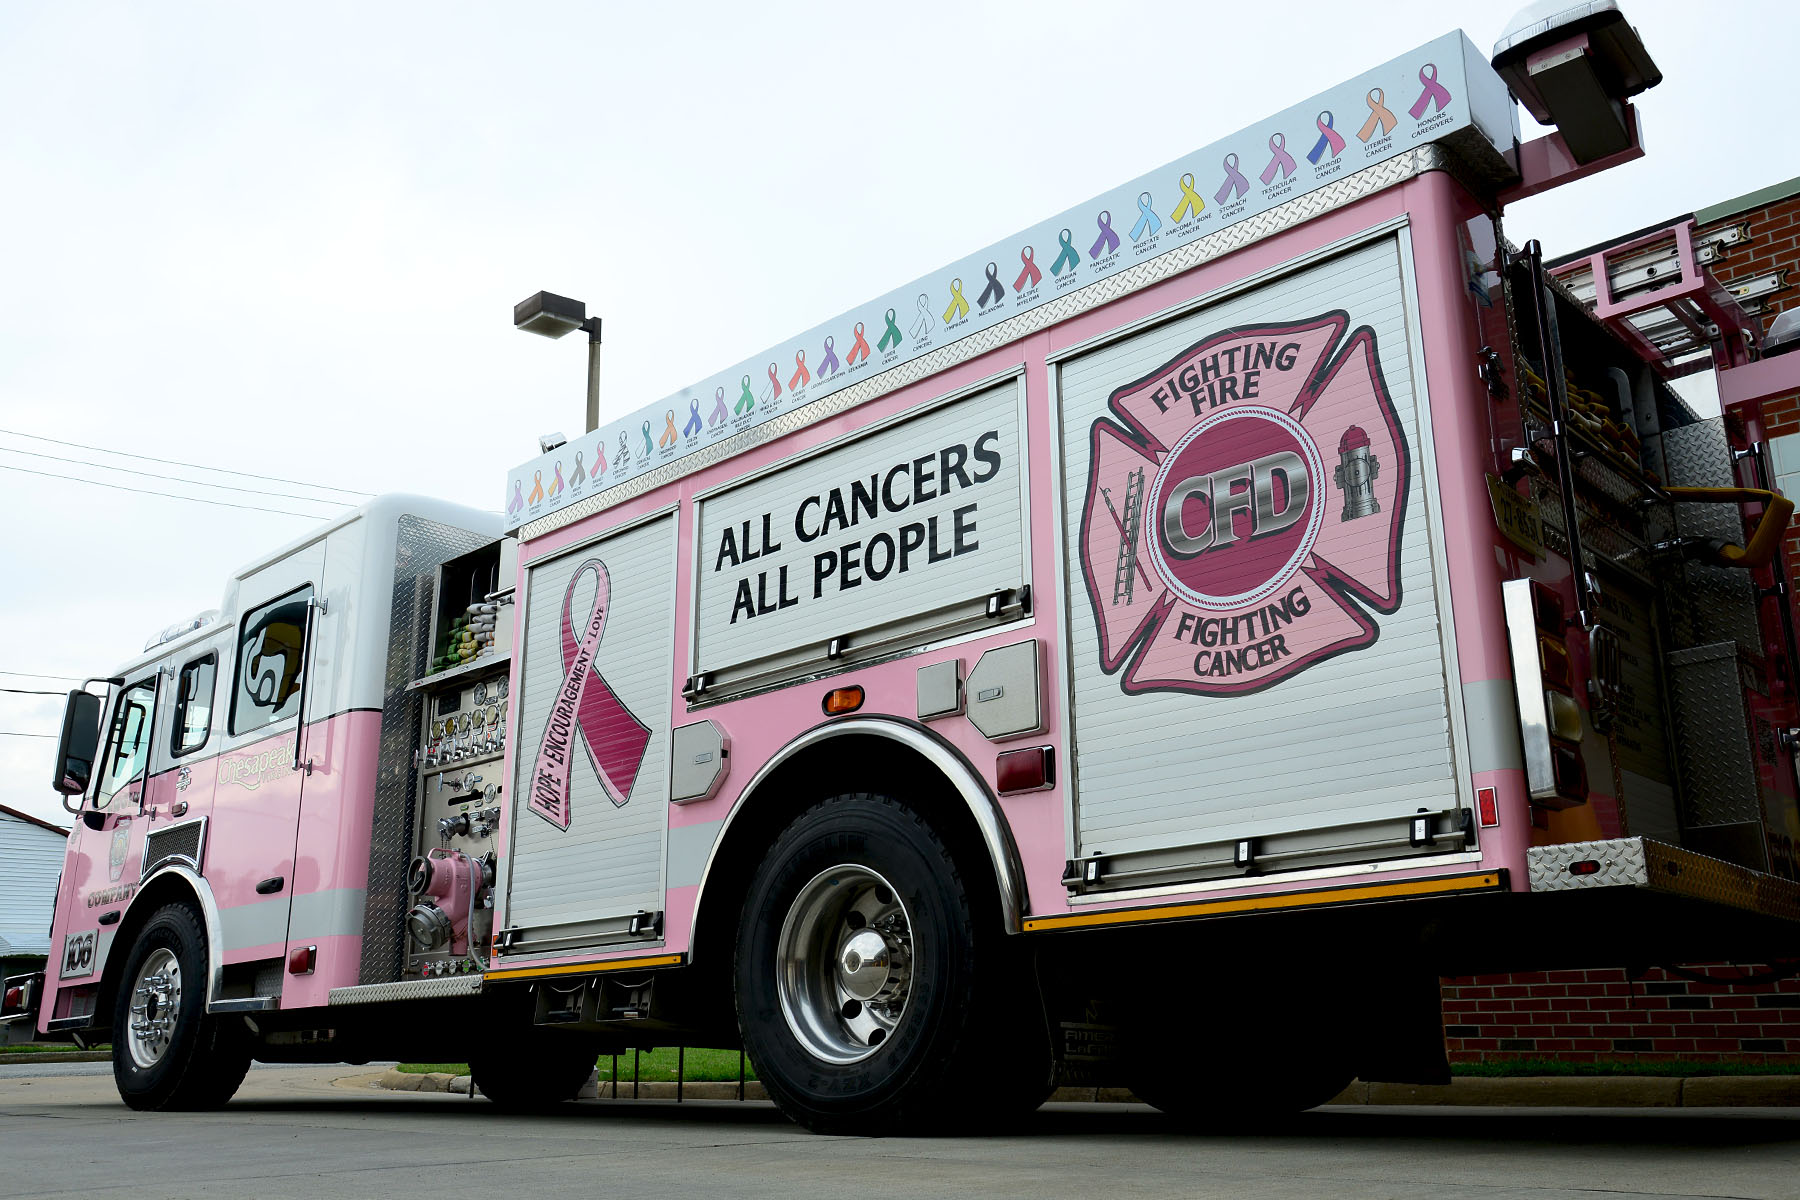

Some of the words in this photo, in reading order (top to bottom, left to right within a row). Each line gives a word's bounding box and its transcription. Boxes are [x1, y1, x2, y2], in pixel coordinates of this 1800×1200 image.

[1411, 116, 1454, 139] CAREGIVERS
[1417, 111, 1447, 129] HONORS
[1364, 135, 1392, 152] UTERINE
[1365, 143, 1392, 158] CANCER
[1314, 157, 1342, 173] THYROID
[1315, 165, 1341, 180] CANCER
[1262, 176, 1297, 196] TESTICULAR
[1267, 186, 1292, 200] CANCER
[1219, 198, 1247, 214] STOMACH
[1221, 206, 1245, 220] CANCER
[1165, 222, 1192, 237] SARCOMA
[1197, 213, 1212, 222] BONE
[1177, 225, 1200, 238] CANCER
[1132, 235, 1160, 251] PROSTATE
[1135, 243, 1157, 256] CANCER
[1089, 252, 1121, 269] PANCREATIC
[1094, 261, 1116, 274] CANCER
[1054, 271, 1077, 284] OVARIAN
[1056, 279, 1076, 291] CANCER
[1016, 288, 1039, 301] MULTIPLE
[1016, 294, 1040, 307] MYELOMA
[978, 302, 1005, 317] MELANOMA
[1149, 342, 1301, 415] FIGHTING
[1189, 371, 1260, 416] FIRE
[714, 512, 782, 572] ALL
[794, 430, 1001, 543] CANCERS
[1161, 450, 1311, 559] CFD
[729, 564, 799, 625] ALL
[812, 502, 979, 600] PEOPLE
[588, 605, 605, 639] LOVE
[1173, 585, 1312, 648] FIGHTING
[1193, 634, 1292, 677] CANCER
[543, 647, 592, 767] ENCOURAGEMENT
[218, 737, 296, 791] Chesapeak
[534, 768, 562, 818] HOPE
[87, 881, 139, 909] COMPANY
[65, 933, 94, 972] 106
